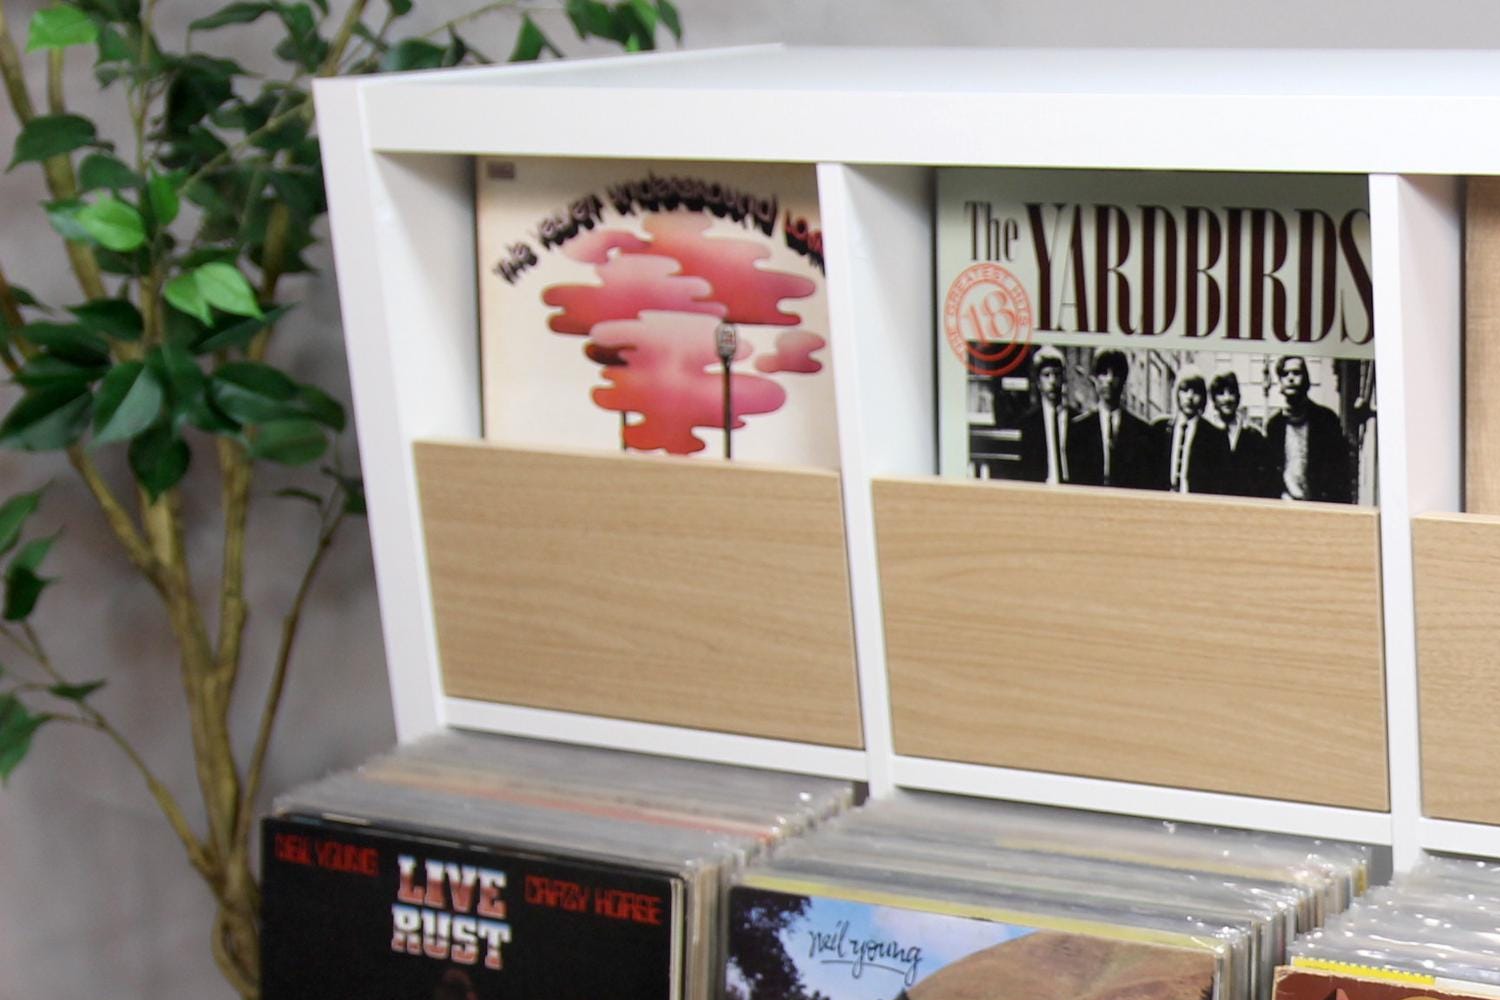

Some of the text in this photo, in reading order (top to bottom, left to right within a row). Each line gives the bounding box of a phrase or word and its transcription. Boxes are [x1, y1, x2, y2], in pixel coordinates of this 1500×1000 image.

[965, 201, 1375, 346] The YARDBIRDS
[962, 289, 1018, 348] 18
[396, 854, 507, 919] LIVE
[593, 886, 663, 926] HORSE
[391, 903, 512, 970] RUST
[849, 939, 923, 987] young
